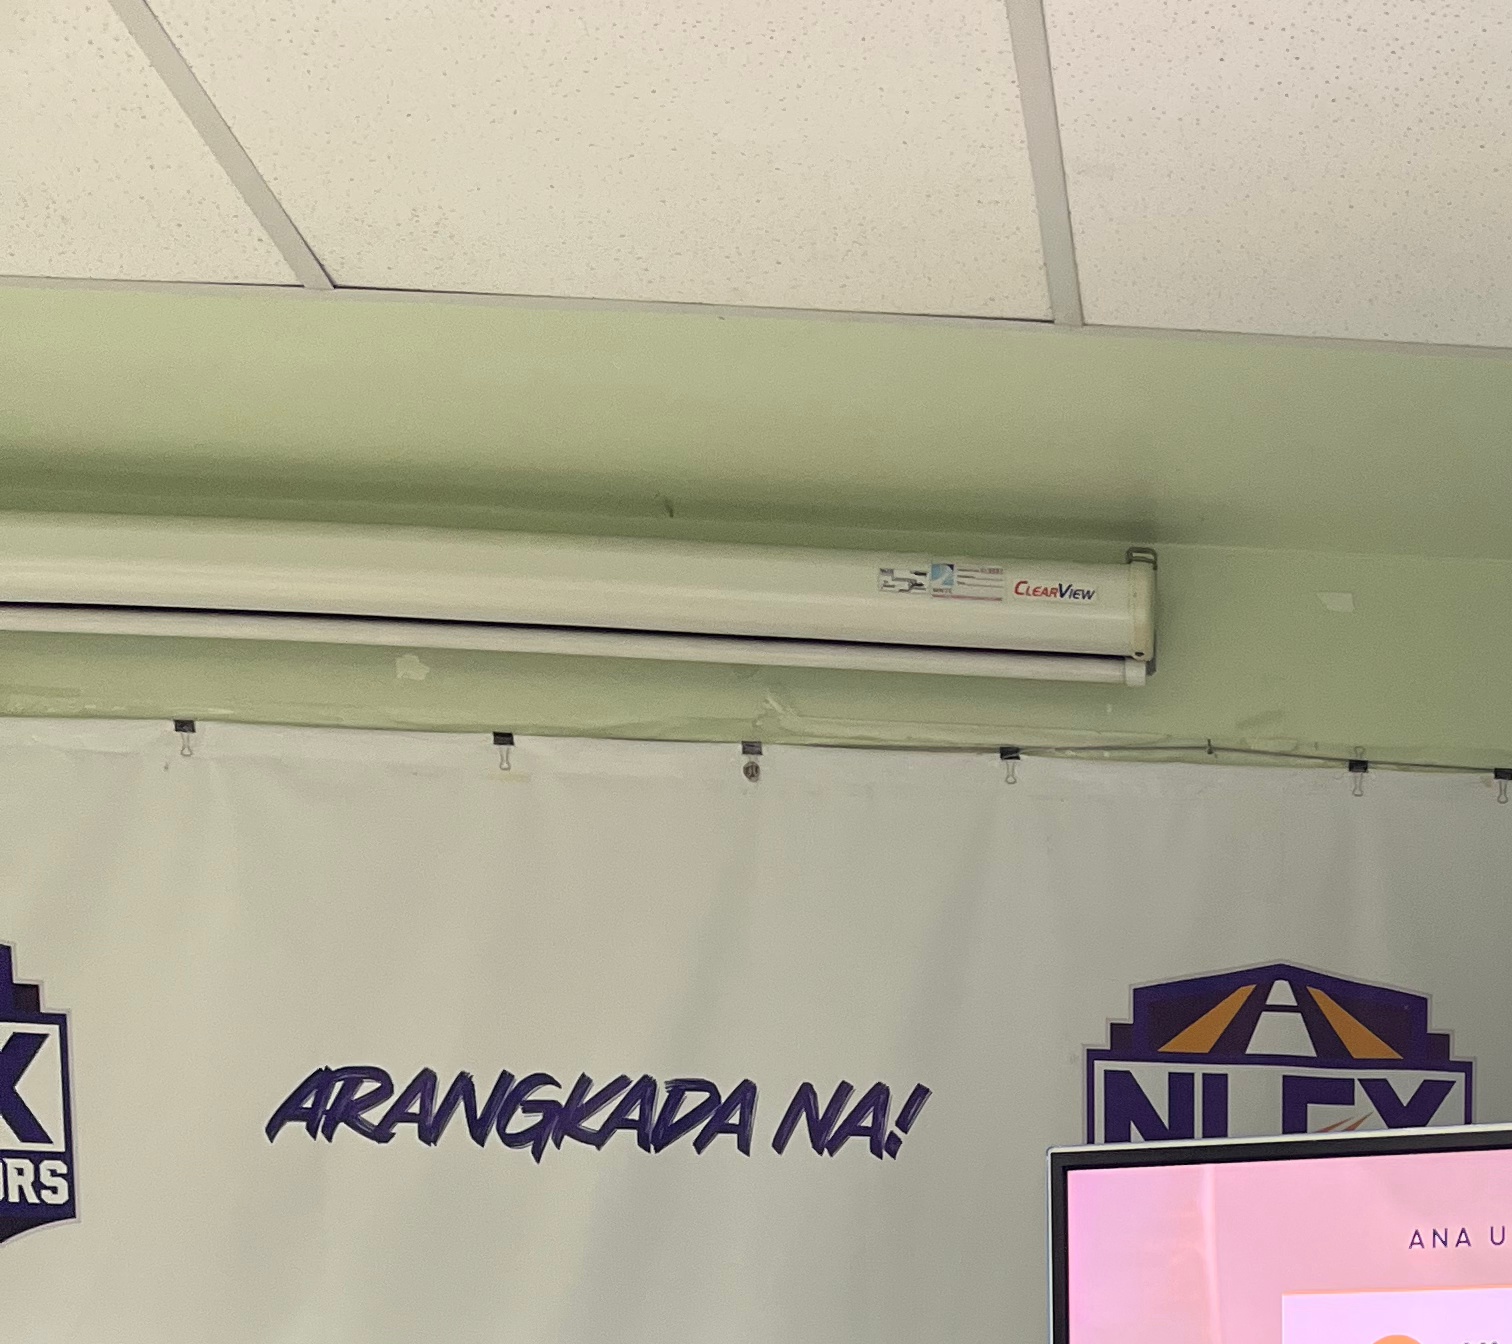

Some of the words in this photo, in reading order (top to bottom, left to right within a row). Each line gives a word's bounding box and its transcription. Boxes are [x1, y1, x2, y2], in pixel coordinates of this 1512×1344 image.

[265, 1065, 757, 1163] ARANGKADA
[772, 1080, 933, 1160] NA!
[1408, 1228, 1473, 1250] ANA
